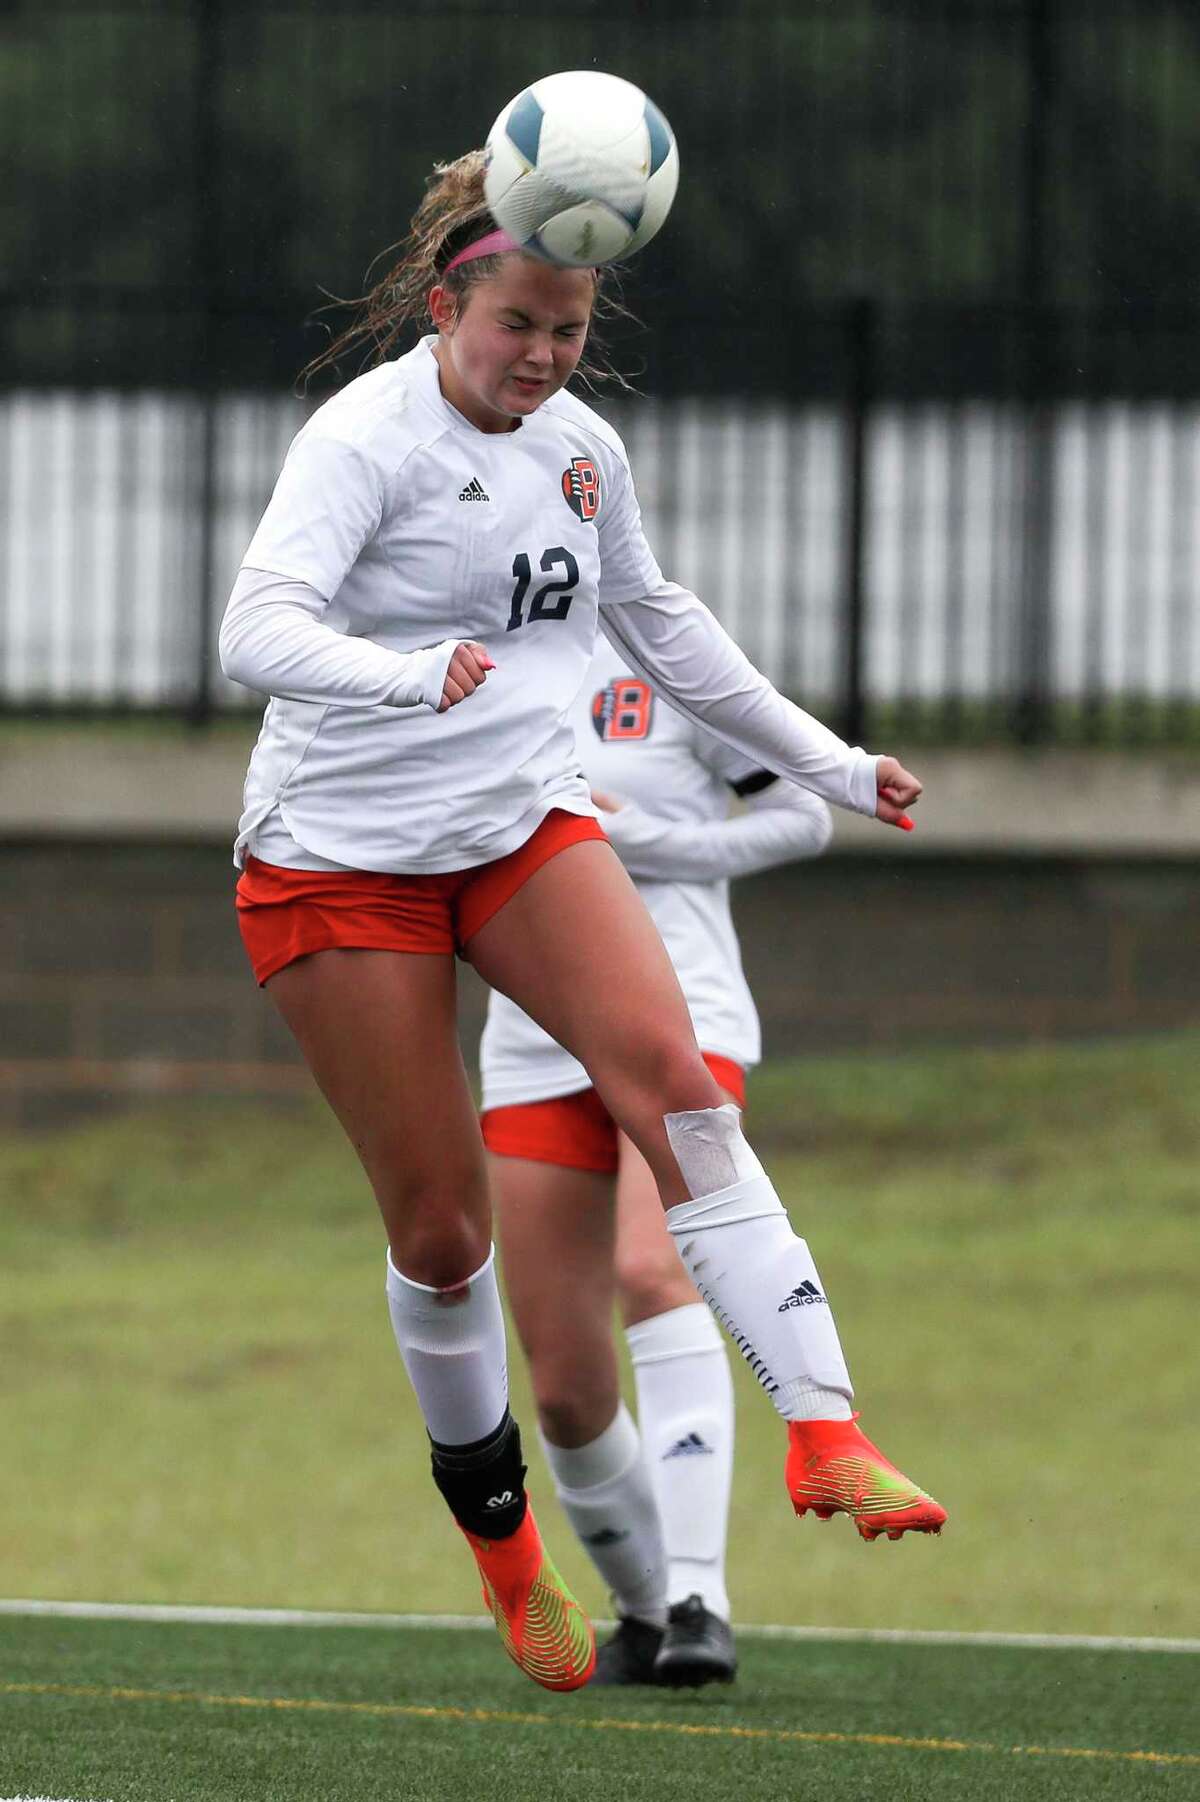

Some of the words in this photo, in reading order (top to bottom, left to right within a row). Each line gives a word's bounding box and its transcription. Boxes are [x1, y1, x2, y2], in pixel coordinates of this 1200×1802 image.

[458, 491, 490, 502] adidas
[571, 457, 600, 522] B
[506, 546, 580, 632] 12
[602, 677, 655, 742] B
